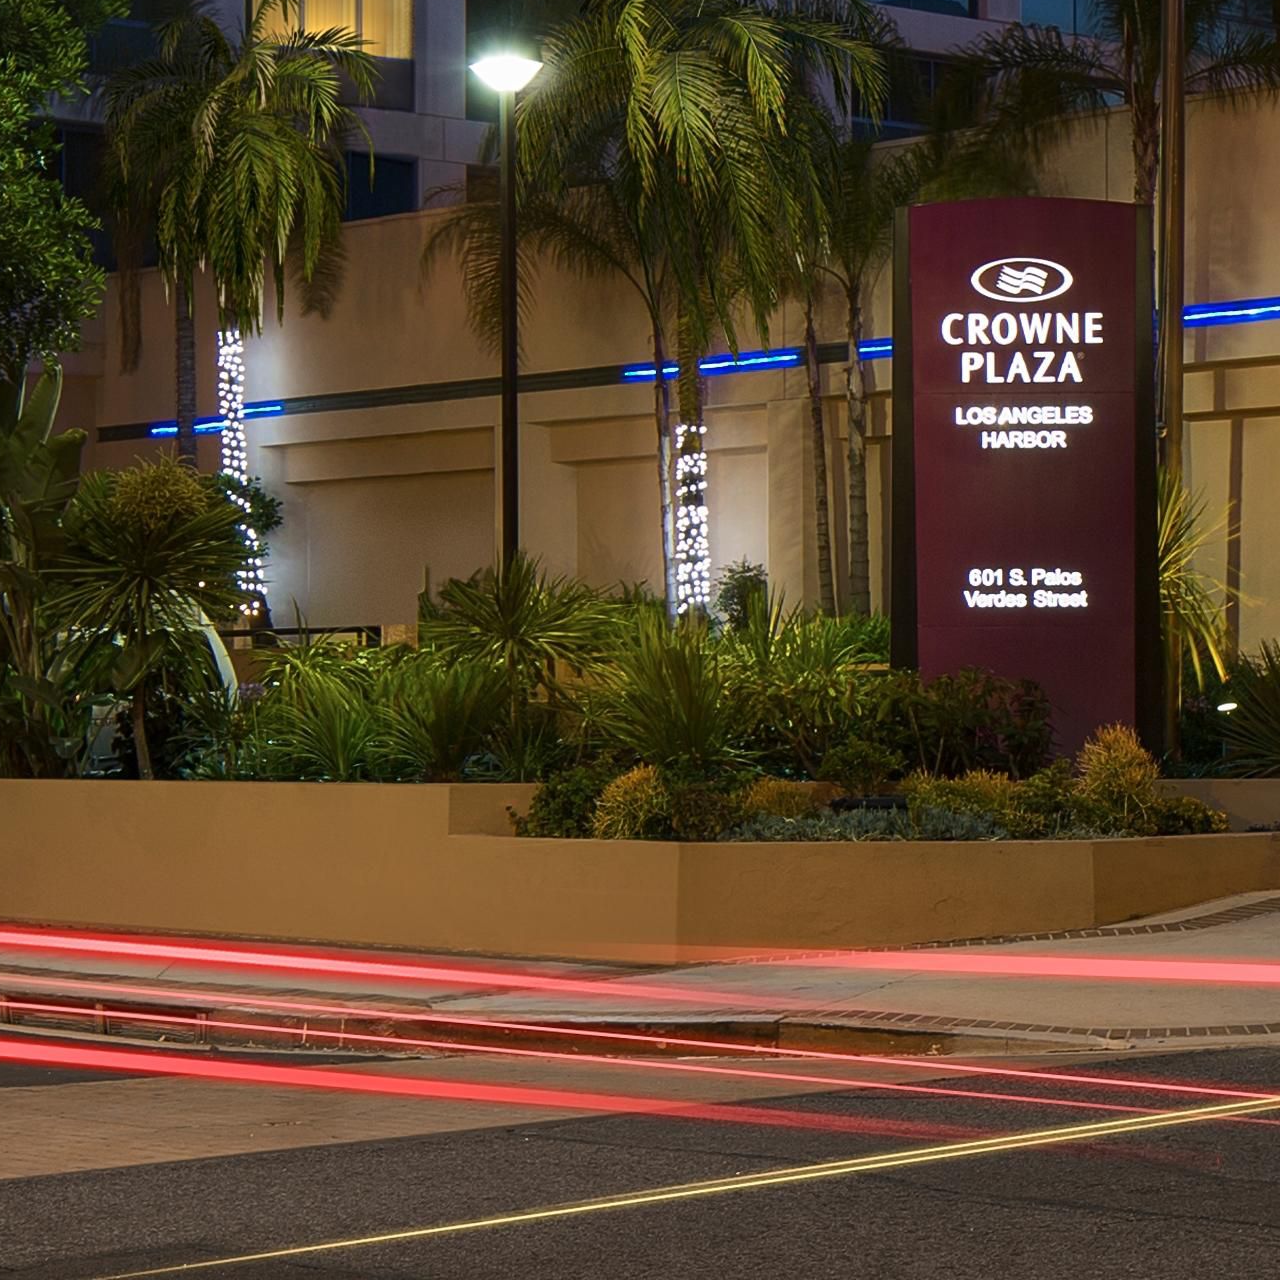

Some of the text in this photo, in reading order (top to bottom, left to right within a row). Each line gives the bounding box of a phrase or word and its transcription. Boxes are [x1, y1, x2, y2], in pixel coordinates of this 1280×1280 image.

[941, 312, 1104, 346] CROWNE
[961, 351, 1084, 384] PLAZA
[955, 405, 1094, 426] LOS ANGELES
[981, 430, 1068, 450] HARBOR
[968, 567, 1083, 587] 601 S. Palos
[963, 589, 1089, 609] Verdes Street
